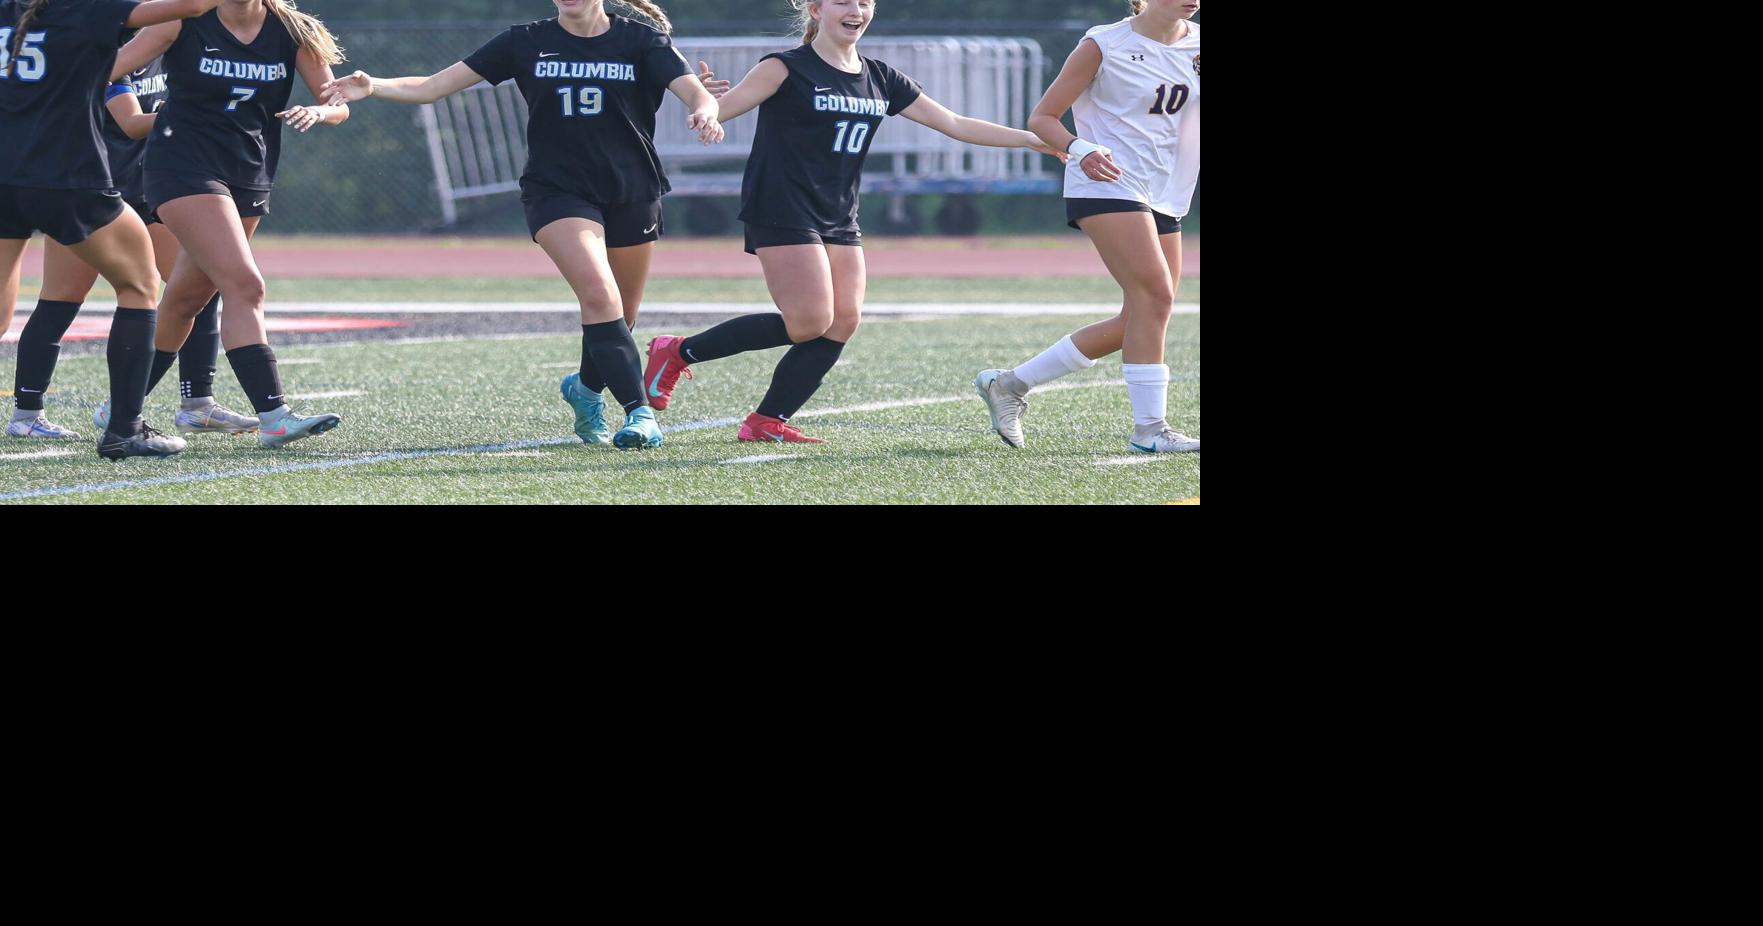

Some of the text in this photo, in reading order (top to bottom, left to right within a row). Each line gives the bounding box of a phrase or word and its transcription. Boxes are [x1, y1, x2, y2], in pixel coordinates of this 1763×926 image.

[535, 61, 636, 81] COLUMBIA
[226, 87, 256, 111] 7
[557, 86, 604, 116] 19
[1148, 83, 1190, 115] 10
[832, 120, 870, 154] 10
